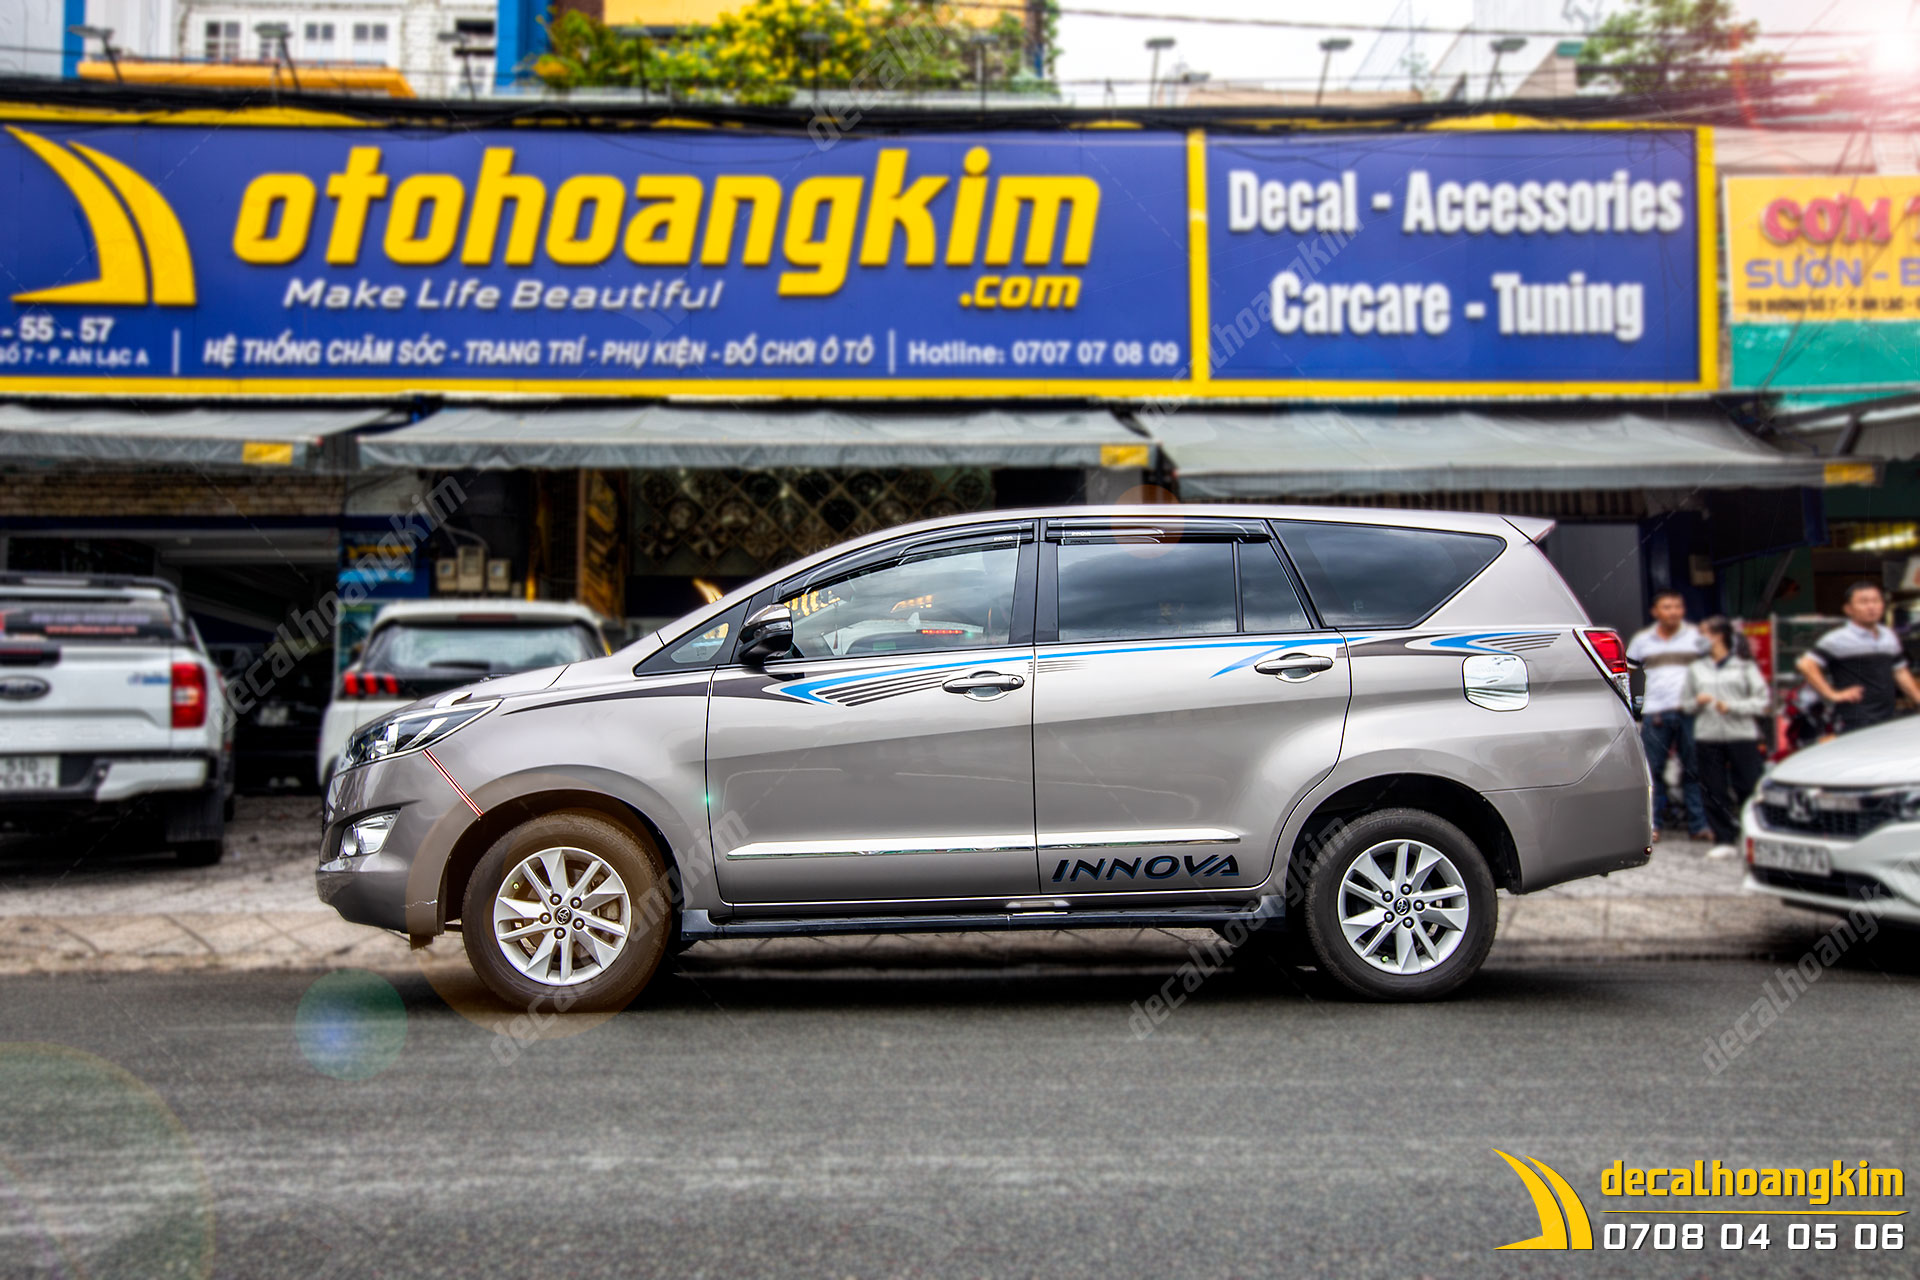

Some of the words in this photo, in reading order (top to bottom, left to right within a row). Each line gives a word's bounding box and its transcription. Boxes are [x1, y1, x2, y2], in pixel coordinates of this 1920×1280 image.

[1228, 170, 1357, 233] Decal
[1402, 170, 1684, 234] Accessories
[1761, 193, 1892, 246] CƠM
[232, 146, 1101, 296] otohoangkim
[283, 279, 406, 308] Make
[416, 279, 502, 308] Life
[510, 279, 724, 308] Beautiful
[959, 275, 1082, 308] .com
[1270, 271, 1449, 335] Carcare
[1493, 272, 1644, 341] Tuning
[20, 315, 55, 343] 55
[79, 316, 115, 343] 57
[203, 333, 237, 369] HỆ
[243, 328, 321, 365] THỐNG
[327, 334, 394, 365] CHĂM
[397, 333, 447, 366] SÓC
[465, 340, 541, 365] TRANG
[549, 335, 587, 365] TRÍ
[601, 341, 649, 369] PHỤ
[653, 336, 706, 369] KIỆN
[908, 340, 1005, 364] Hotline:
[1012, 341, 1070, 365] 0707
[1077, 341, 1106, 365] 07
[1113, 341, 1143, 365] 08
[1149, 341, 1179, 365] 09
[1052, 854, 1240, 882] INNOVA
